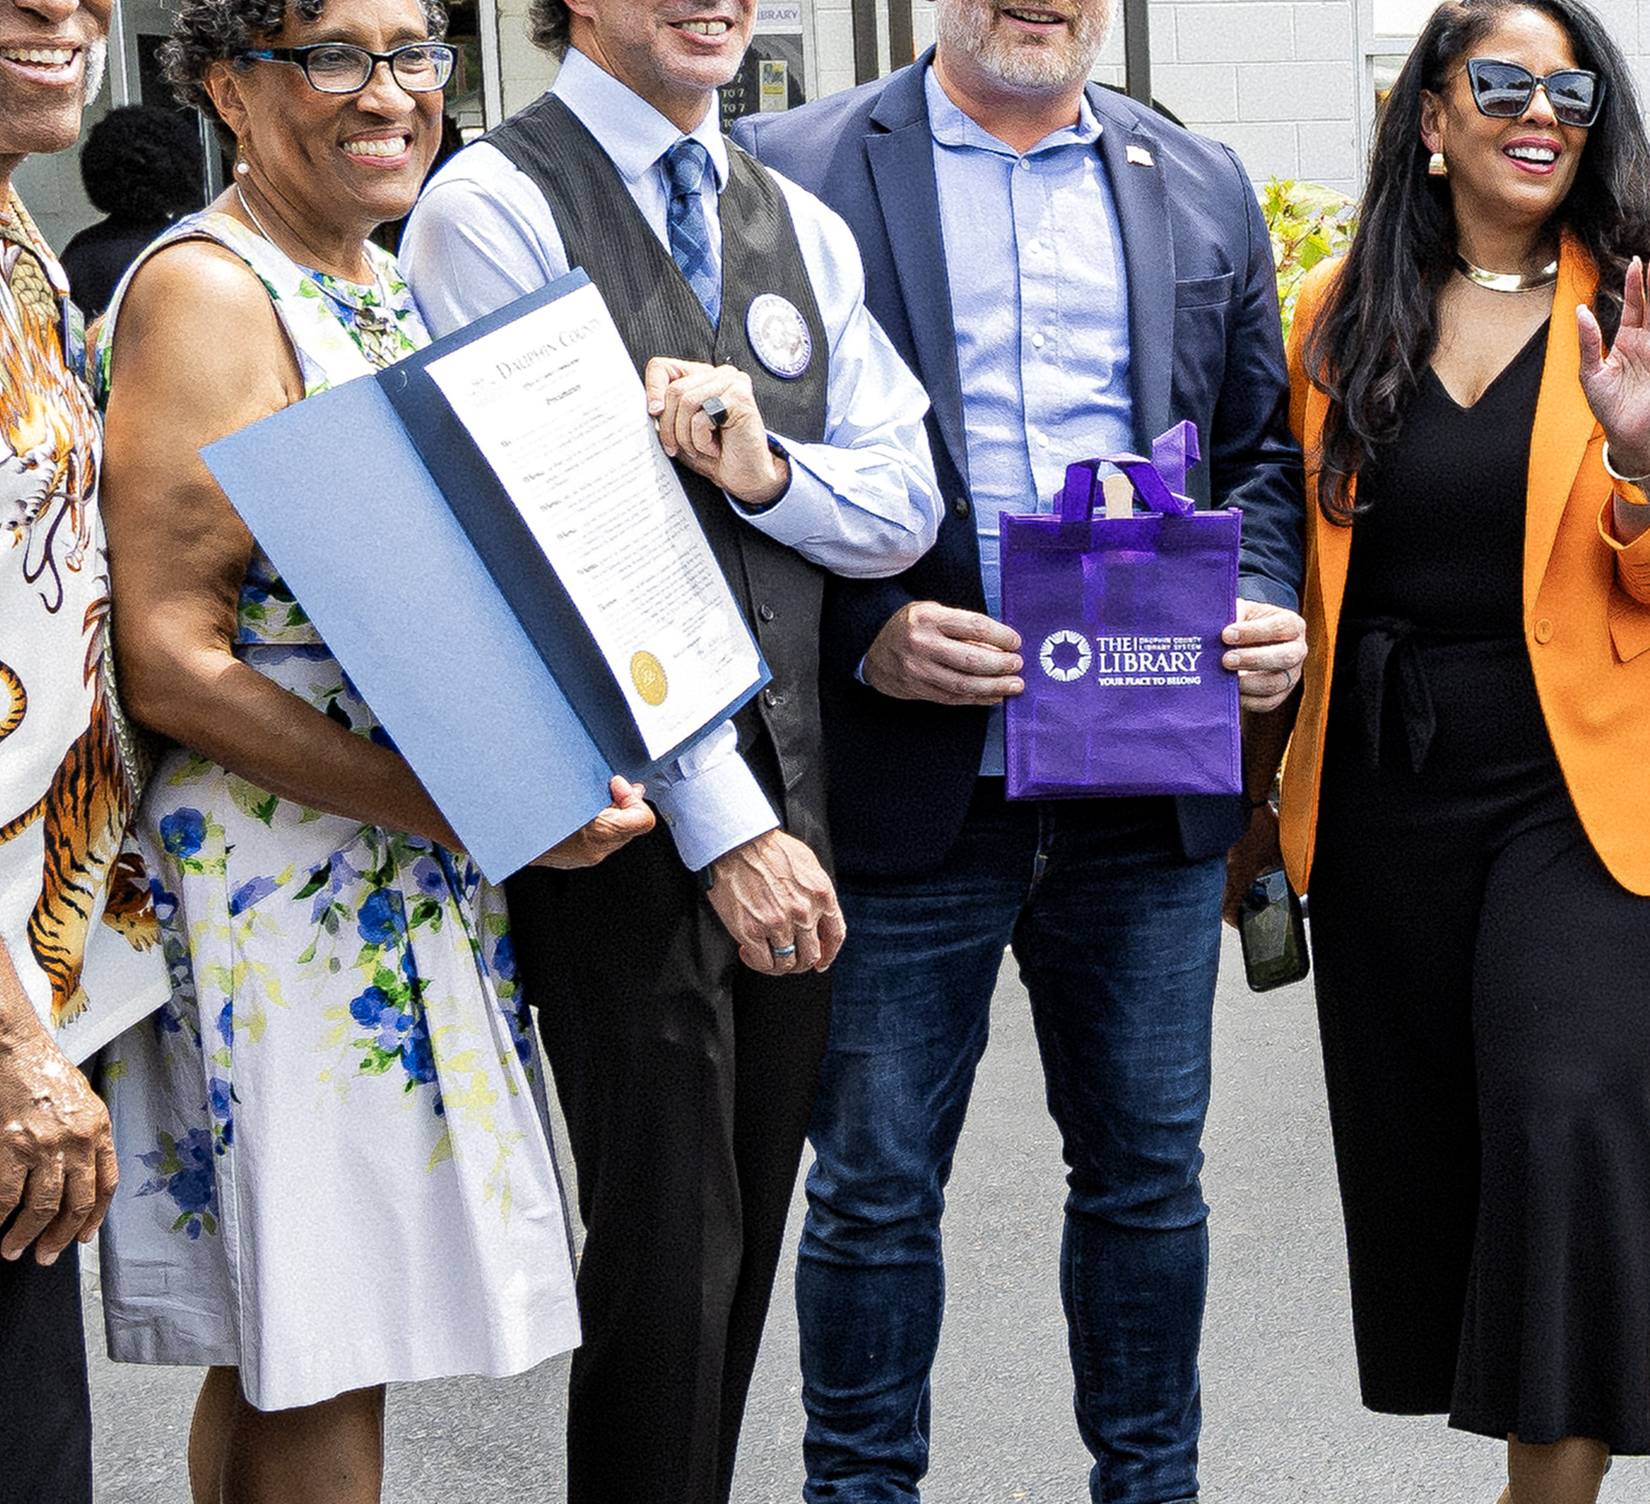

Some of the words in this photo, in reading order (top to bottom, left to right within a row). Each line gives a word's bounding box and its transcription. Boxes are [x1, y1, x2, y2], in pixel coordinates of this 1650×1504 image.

[757, 10, 798, 21] IBRARY
[1095, 637, 1132, 652] THE
[1098, 651, 1204, 674] LIBRARY
[1097, 677, 1125, 687] YOUR
[1151, 677, 1166, 686] TO
